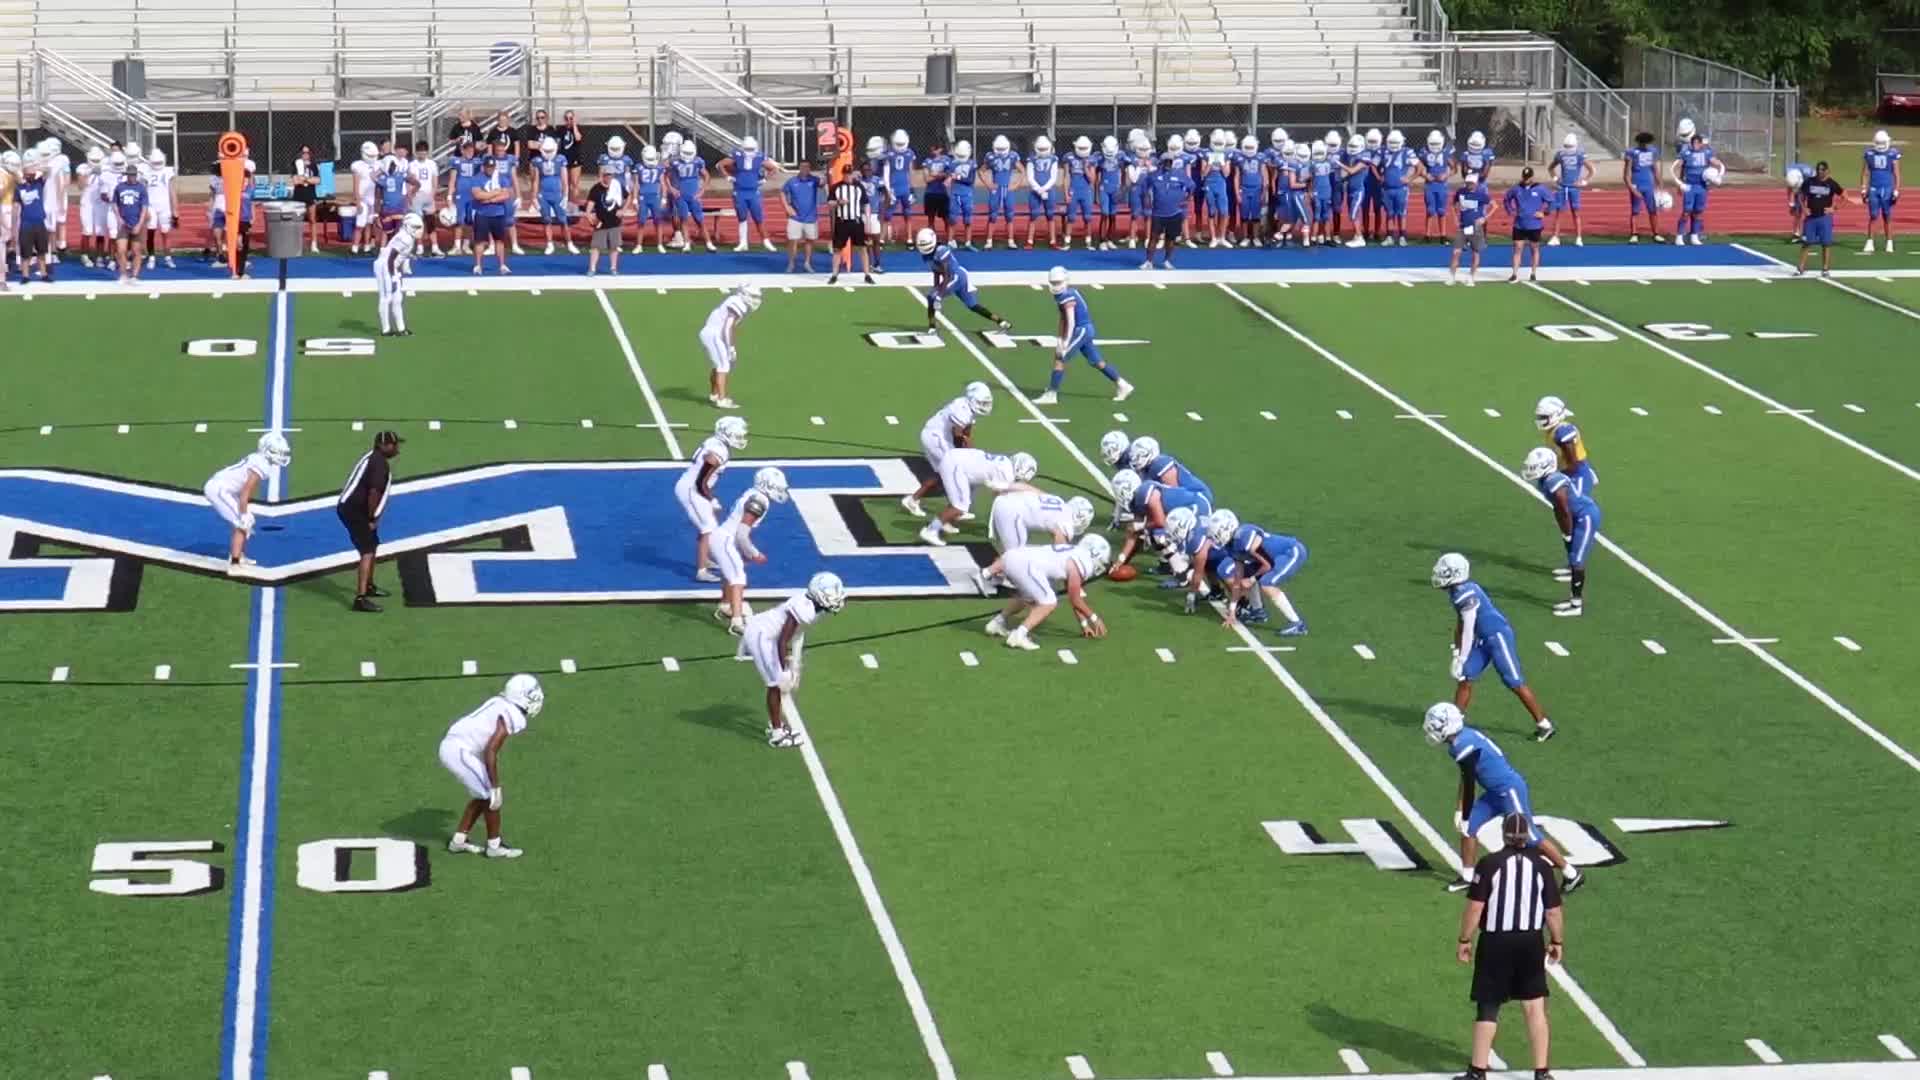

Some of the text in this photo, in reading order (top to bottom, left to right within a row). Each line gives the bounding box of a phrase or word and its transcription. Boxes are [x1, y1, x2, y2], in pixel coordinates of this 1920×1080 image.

[817, 121, 836, 146] 2
[642, 168, 658, 184] 27
[89, 837, 425, 896] 50
